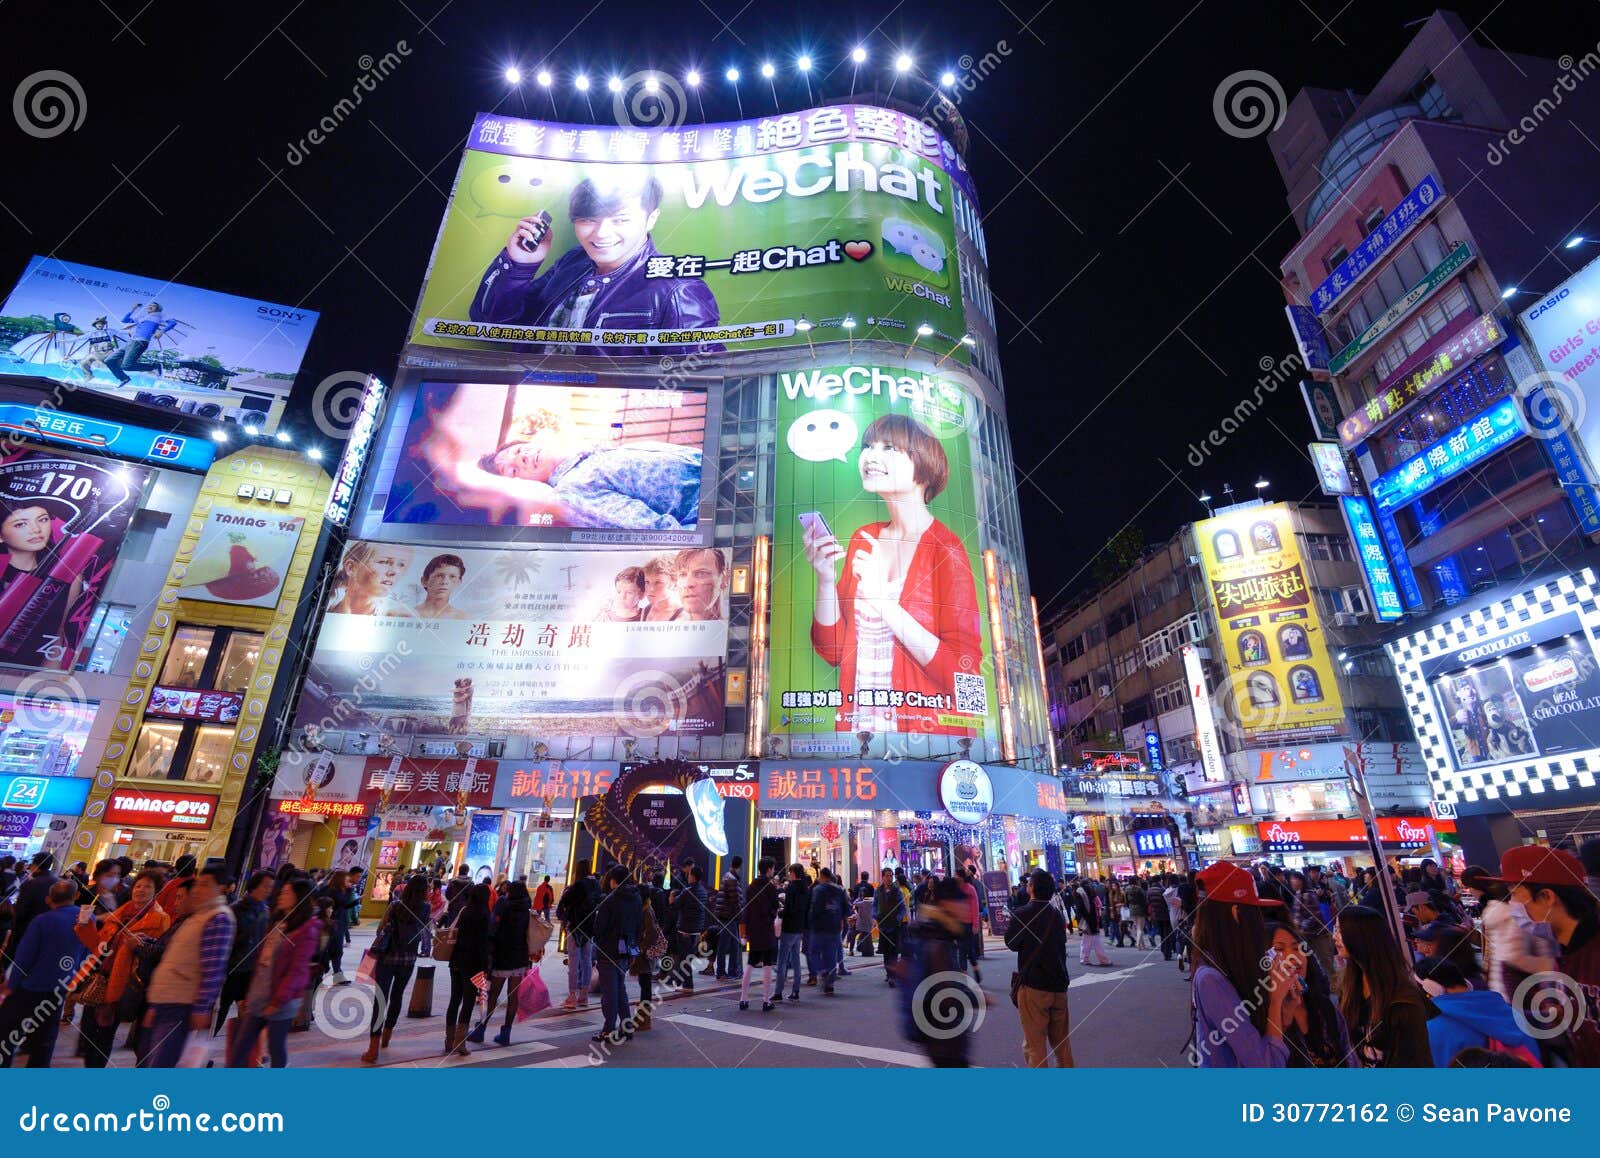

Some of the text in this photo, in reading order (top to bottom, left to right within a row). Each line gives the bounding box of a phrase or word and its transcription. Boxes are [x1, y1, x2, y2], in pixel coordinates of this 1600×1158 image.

[679, 143, 945, 215] WeChat
[885, 275, 952, 309] WeChat
[256, 305, 307, 321] SONY
[1528, 287, 1571, 322] CASIO
[780, 366, 938, 404] WeChat
[9, 482, 24, 492] up
[25, 483, 37, 492] to
[327, 501, 348, 523] 8F
[465, 622, 592, 649] 浩劫奇蹟
[491, 649, 508, 657] THE
[1552, 689, 1579, 704] WEAR
[12, 783, 39, 799] 24
[716, 784, 754, 798] AISO
[768, 768, 877, 799] 誠品116
[113, 796, 211, 815] TAMAGOYA
